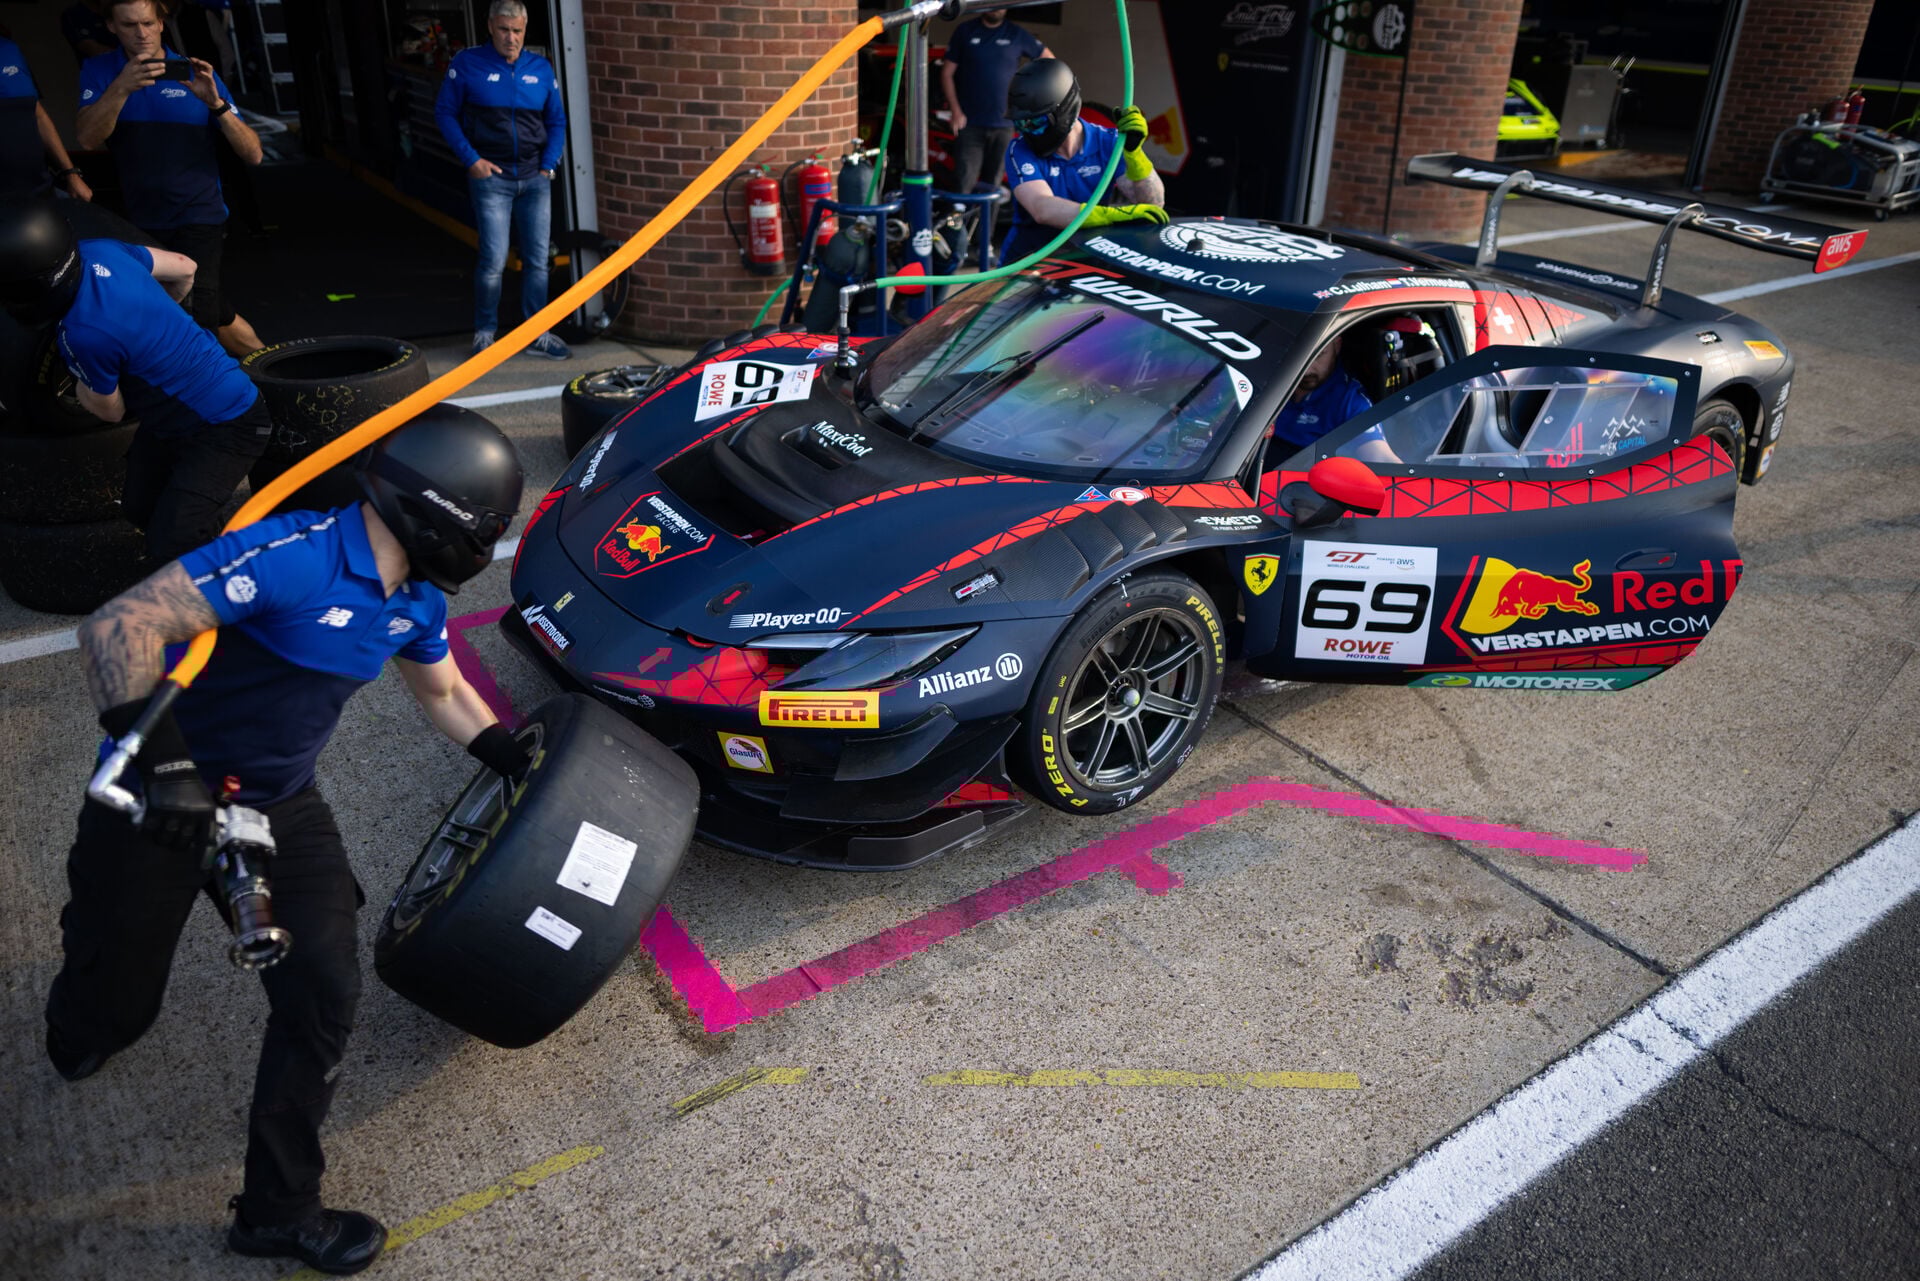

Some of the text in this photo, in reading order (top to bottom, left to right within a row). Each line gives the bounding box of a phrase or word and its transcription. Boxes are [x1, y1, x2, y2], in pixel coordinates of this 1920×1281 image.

[1827, 235, 1852, 255] aws
[1085, 236, 1266, 296] VERSTAPPEN.COM
[1329, 280, 1392, 296] C.Lulham
[1070, 276, 1262, 360] WORLD
[708, 374, 726, 406] ROWE
[811, 420, 873, 458] MaxiCool
[1619, 435, 1647, 450] CAPITAL
[647, 495, 708, 543] VERSTAPPEN.COM
[654, 513, 680, 534] RACING
[1326, 550, 1377, 563] GT
[1397, 558, 1415, 566] aws
[1611, 559, 1714, 613] Red
[1301, 579, 1431, 634] 69
[1186, 595, 1224, 665] PIRELLI
[1324, 638, 1394, 654] ROWE
[1471, 614, 1710, 652] VERSTAPPEN.COM
[919, 666, 993, 698] Allianz
[1474, 675, 1617, 690] MOTOREX
[769, 699, 868, 722] PIRELLI
[1042, 734, 1075, 797] ZERO
[1070, 797, 1089, 807] P
